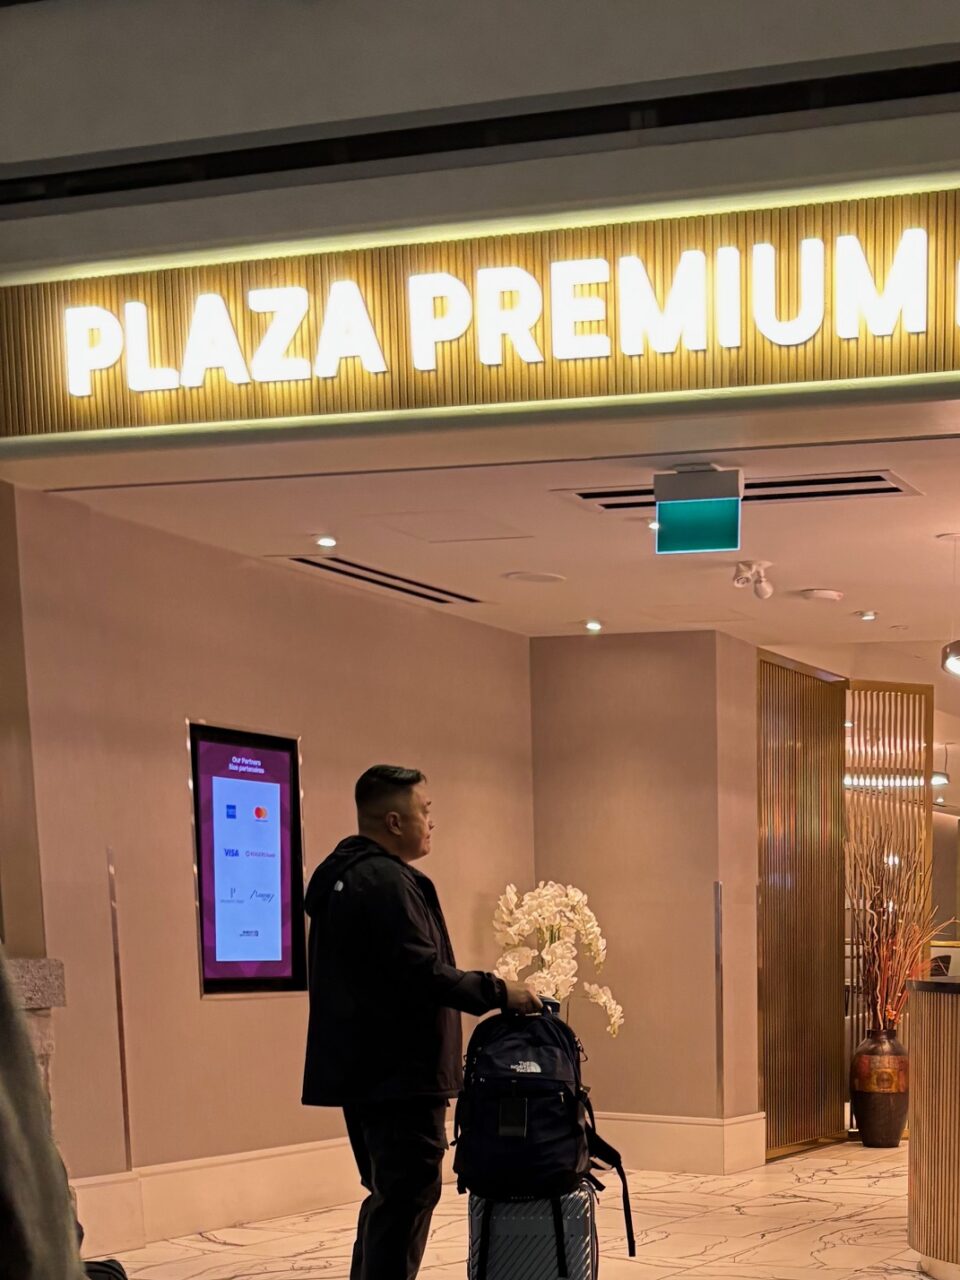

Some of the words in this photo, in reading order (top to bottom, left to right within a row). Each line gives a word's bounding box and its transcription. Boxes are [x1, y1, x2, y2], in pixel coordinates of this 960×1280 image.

[64, 279, 388, 397] PLAZA
[408, 228, 927, 371] PREMIUM
[231, 756, 241, 764] Our
[241, 757, 262, 766] Partners
[224, 848, 240, 857] VISA
